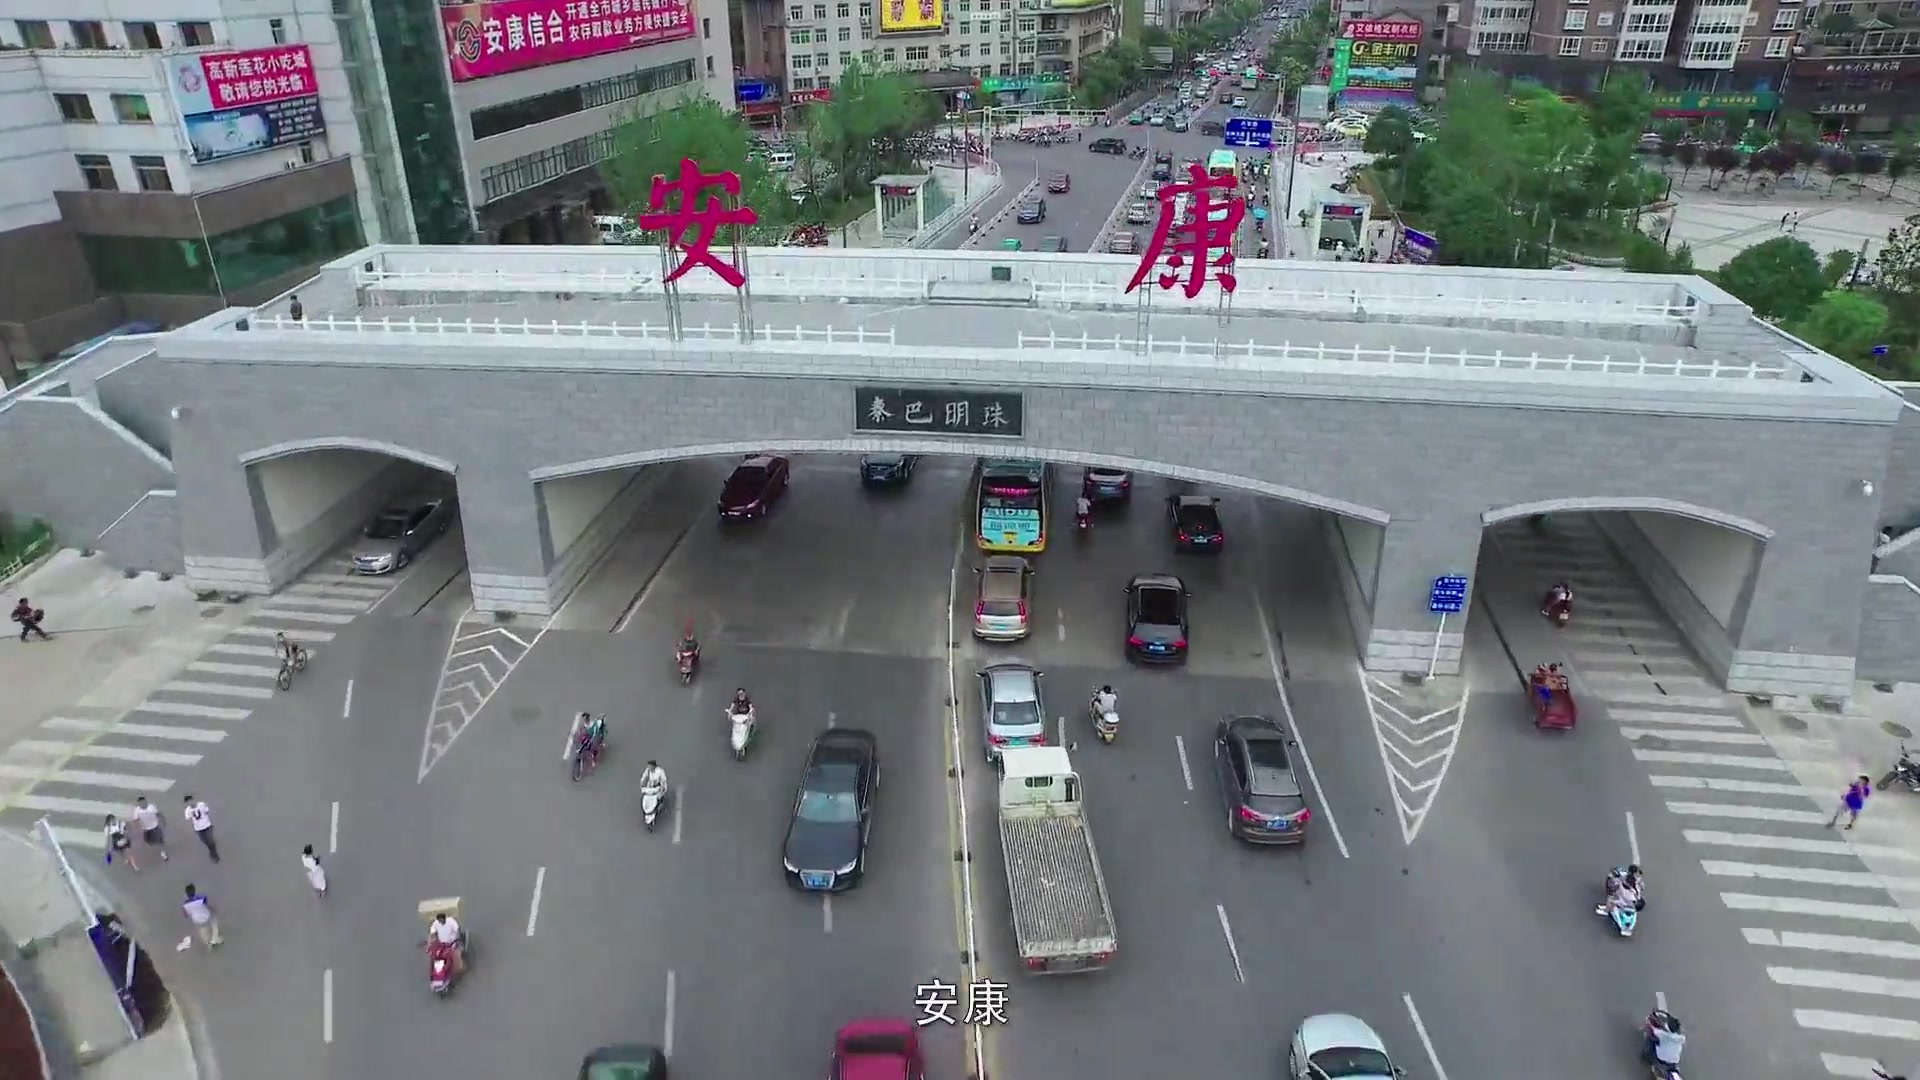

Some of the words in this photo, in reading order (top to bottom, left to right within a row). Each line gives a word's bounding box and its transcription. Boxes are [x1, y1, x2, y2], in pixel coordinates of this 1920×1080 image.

[483, 9, 564, 54] 安康信合
[1371, 42, 1418, 57] 金丰木门
[205, 50, 307, 81] 高新莲花小吃城
[867, 396, 1011, 428] 秦巴明珠
